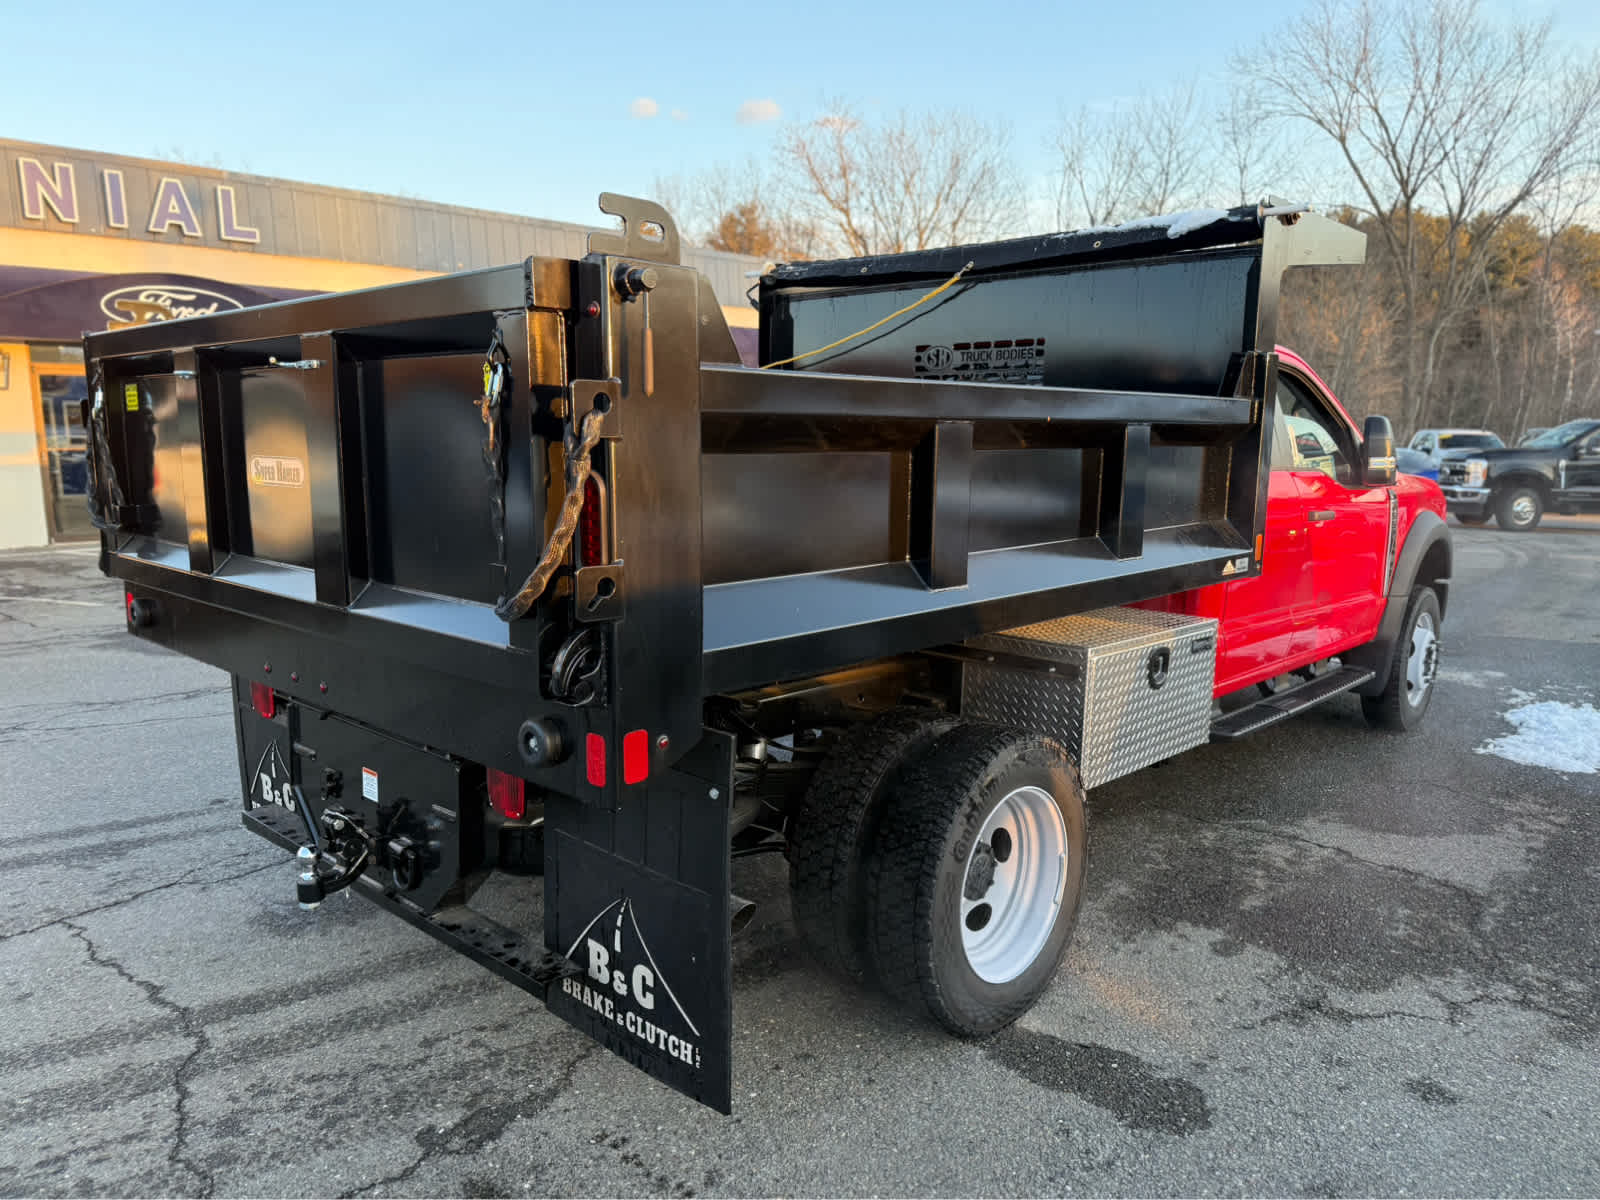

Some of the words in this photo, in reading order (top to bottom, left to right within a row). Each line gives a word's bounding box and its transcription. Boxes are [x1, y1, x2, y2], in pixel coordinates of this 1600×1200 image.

[18, 156, 261, 243] NIAL
[960, 350, 992, 362] TRUCK
[995, 348, 1034, 361] BODIES
[562, 976, 614, 1021] BRAKE
[625, 1010, 693, 1065] CLUTCH
